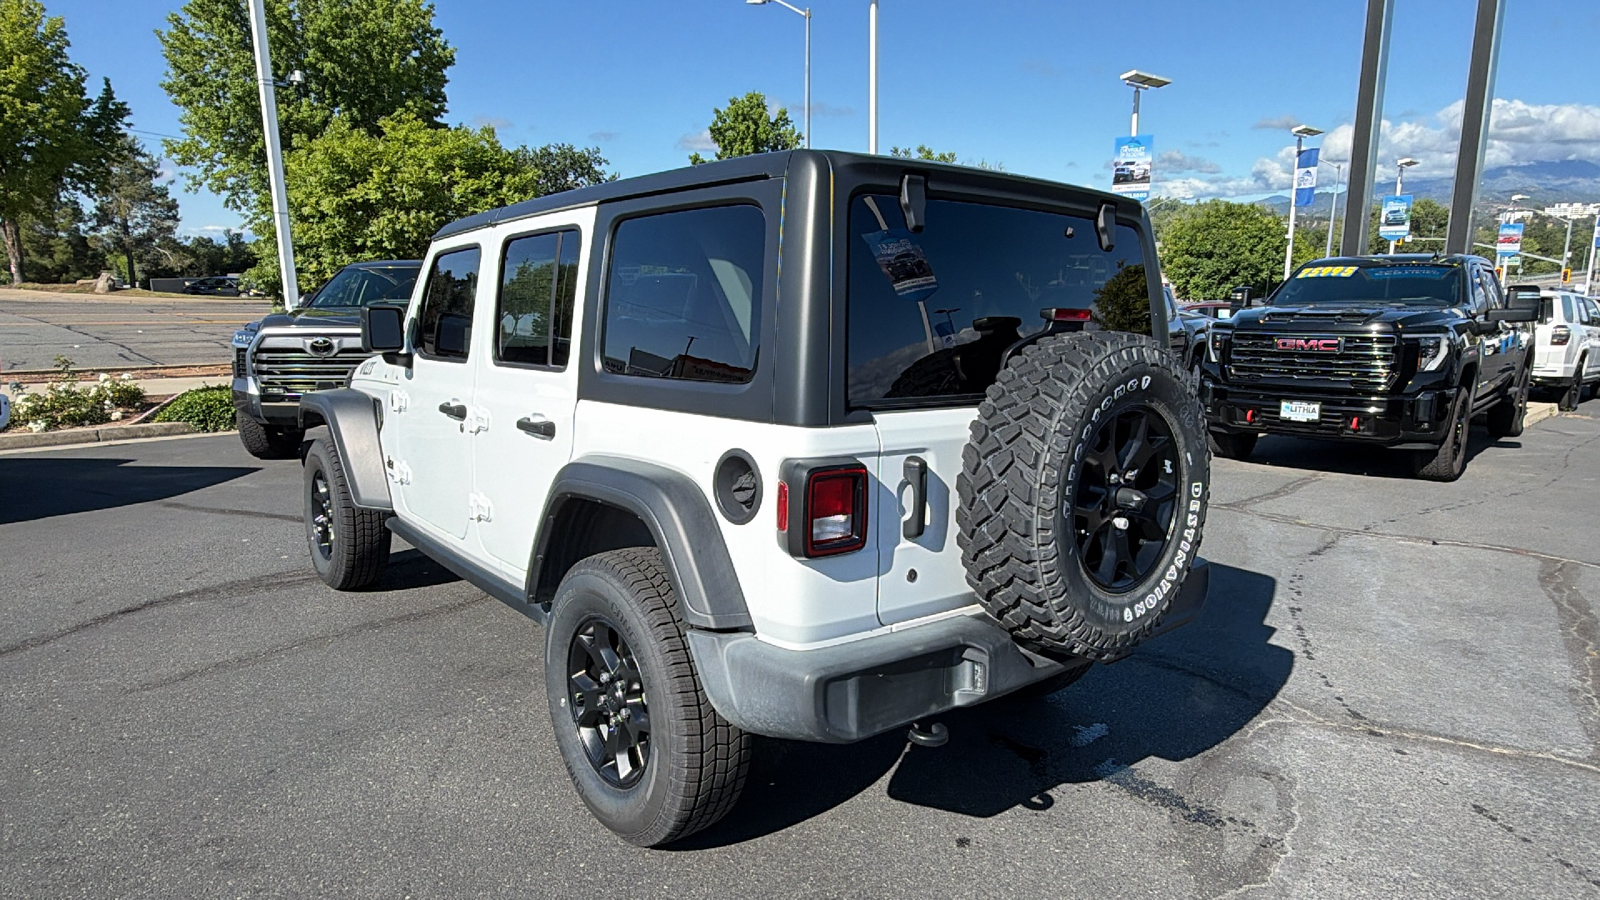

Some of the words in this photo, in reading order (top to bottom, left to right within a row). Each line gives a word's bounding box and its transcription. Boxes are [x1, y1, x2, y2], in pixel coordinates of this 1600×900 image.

[1277, 338, 1338, 351] GMC
[1290, 404, 1317, 414] LITHIA
[1134, 482, 1203, 618] DESTINATION
